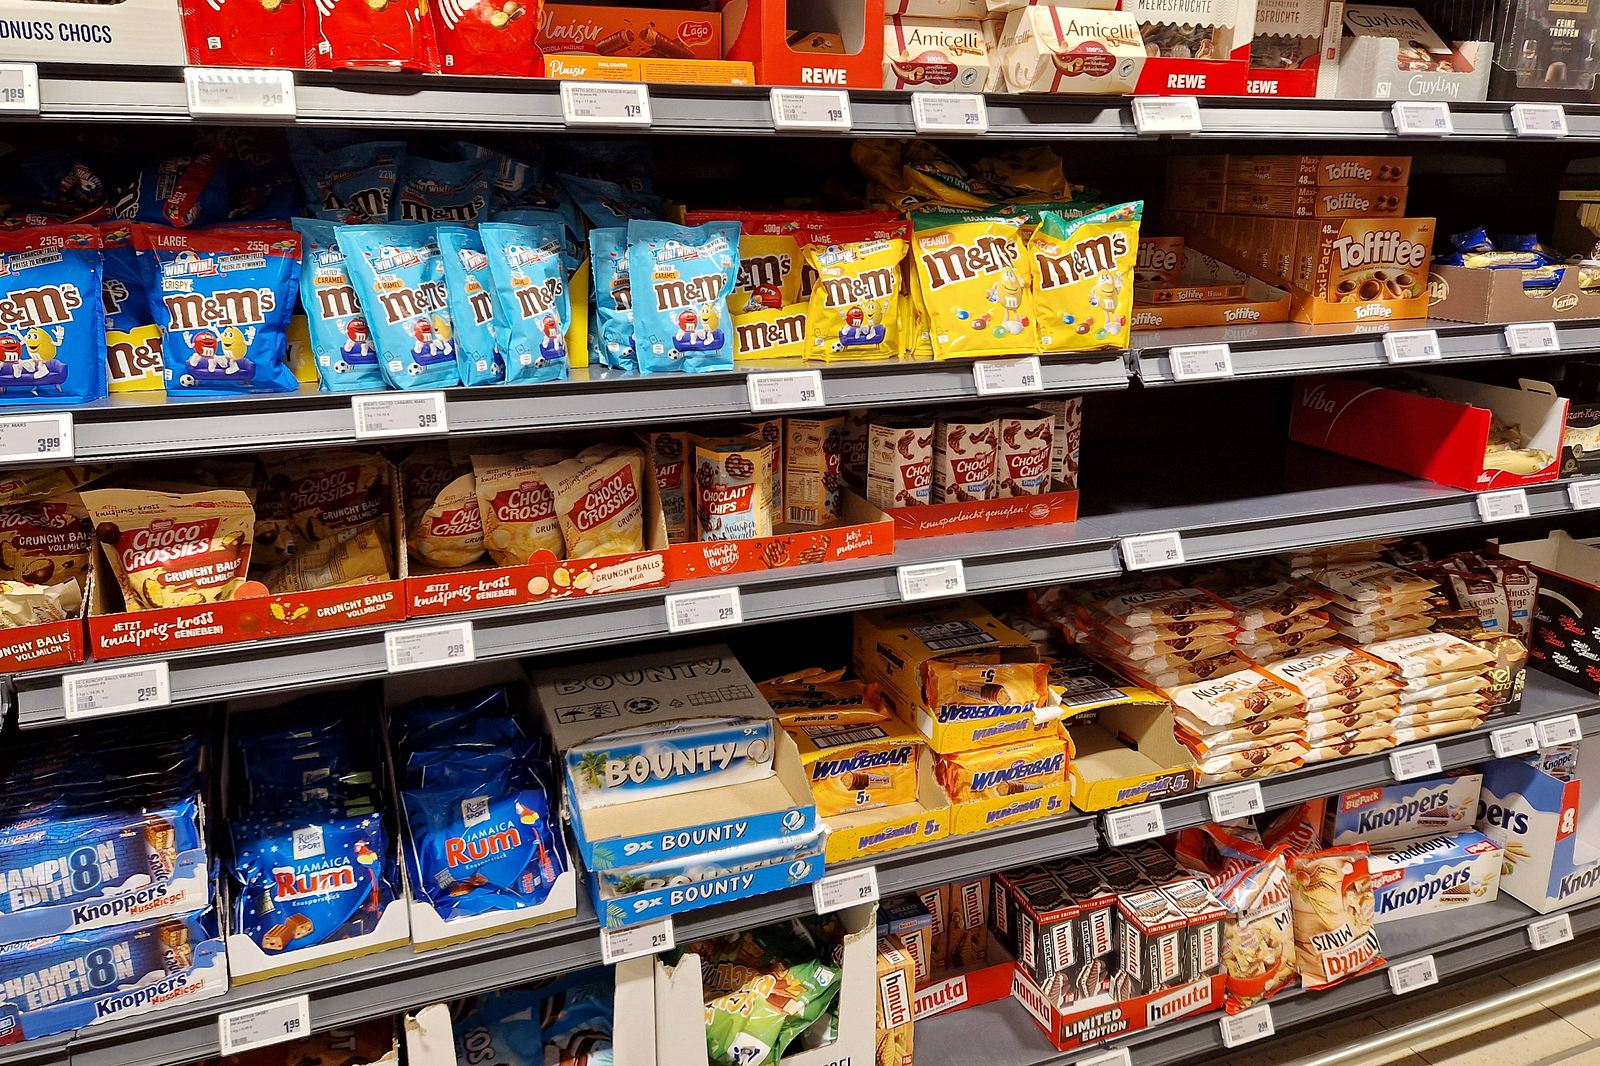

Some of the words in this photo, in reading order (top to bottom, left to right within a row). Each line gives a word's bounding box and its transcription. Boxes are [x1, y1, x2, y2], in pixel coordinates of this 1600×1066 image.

[683, 24, 708, 37] Lago
[1065, 20, 1134, 39] Amicelli
[1549, 28, 1579, 37] TROPFEN
[1556, 19, 1575, 28] FEINE
[59, 24, 112, 44] CHOCS
[908, 29, 978, 48] Amicelli
[550, 59, 587, 77] Plaisir
[802, 67, 847, 84] REWE
[1167, 74, 1207, 89] REWE
[1247, 80, 1278, 94] REWE
[1298, 175, 1308, 184] 48
[1325, 162, 1373, 181] Toffifee
[1296, 207, 1306, 216] 48
[1322, 193, 1370, 211] Toffifee
[764, 224, 781, 234] 300g
[811, 234, 832, 243] LARGE
[874, 231, 890, 240] 300g
[1321, 224, 1332, 234] 48
[40, 236, 64, 247] 255g
[158, 235, 187, 246] LARGE
[247, 240, 269, 254] 255g
[923, 234, 949, 247] PEANUT
[1332, 230, 1426, 270] Toffifee
[165, 263, 188, 276] WIN!
[188, 260, 212, 272] WIN!
[1037, 232, 1127, 289] m&m's
[164, 281, 188, 289] CRISPY
[317, 276, 344, 284] CARAMEL
[655, 272, 677, 280] CARAMEL
[380, 282, 447, 323] m&m's
[1178, 290, 1203, 300] Toffifee
[165, 290, 274, 329] m&m's
[1223, 307, 1260, 322] Toffifee
[1354, 303, 1392, 318] Toffifee
[1302, 384, 1337, 413] Viba
[418, 413, 437, 428] 3.99
[37, 437, 60, 453] 3.99
[957, 451, 994, 473] CHOCLAIT
[1012, 448, 1049, 468] CHOCLAIT
[965, 467, 990, 482] CHIPS
[1019, 464, 1044, 477] CHIPS
[301, 470, 347, 493] CHOCO
[585, 475, 623, 510] CHOCO
[703, 486, 749, 502] CHOCLAIT
[323, 504, 360, 521] CRUNCHY
[577, 483, 636, 530] CROSSIES
[709, 501, 737, 513] CHIPS
[919, 508, 985, 530] Knusperleicht
[985, 503, 1029, 521] genießen!
[19, 533, 66, 547] CRUNCHY
[132, 524, 200, 551] CHOCO
[122, 537, 210, 572] CROSSIES
[703, 543, 738, 559] Knusper
[708, 552, 740, 568] Brezeln
[164, 566, 213, 583] CRUNCHY
[215, 557, 242, 574] BALLS
[196, 572, 236, 587] VOLLMILCH
[596, 568, 634, 584] CRUNCHY
[636, 560, 661, 574] BALLS
[413, 575, 510, 608] knusprig-kross
[424, 582, 450, 593] JETZT
[317, 600, 362, 618] CRUNCHY
[364, 591, 393, 606] BALLS
[346, 603, 386, 619] VOLLMILCH
[100, 611, 214, 648] knusprig-kross
[112, 620, 141, 632] JETZT
[36, 632, 71, 649] BALLS
[15, 645, 63, 663] VOLLMILCH
[553, 657, 723, 696] BOUNTY
[980, 668, 995, 682] 5x
[137, 686, 158, 702] 2.99
[743, 728, 759, 737] 9x
[971, 717, 1029, 742] WUNDERBAR
[604, 742, 737, 789] BOUNTY
[812, 746, 913, 782] WUNDERBAR
[970, 753, 1064, 792] WUNDERBAR
[1173, 775, 1189, 791] 5x
[856, 789, 870, 805] 5x
[1346, 792, 1379, 811] BigPack
[466, 809, 486, 821] SPORT
[986, 798, 1042, 824] WUNDERBAR
[1047, 795, 1062, 811] 5x
[1358, 788, 1449, 835] Knoppers
[1561, 807, 1577, 834] 8x
[467, 820, 515, 843] JAMAICA
[623, 839, 655, 857] 9x
[660, 821, 748, 851] BOUNTY
[858, 822, 918, 851] WUNDERBAR
[924, 819, 940, 836] 5x
[298, 842, 321, 852] SPORT
[445, 828, 522, 868] Rum
[1387, 836, 1455, 865] Knoppers
[296, 856, 350, 875] JAMAICA
[275, 867, 356, 898] Rum
[1172, 884, 1198, 897] hanuta
[1380, 866, 1471, 915] Knoppers
[130, 889, 185, 915] NussRiegel
[633, 896, 663, 914] 9x
[670, 873, 754, 907] BOUNTY
[1131, 892, 1158, 906] hanuta
[73, 882, 168, 925] Knoppers
[966, 884, 982, 929] hanuta
[925, 892, 941, 936] hanuta
[1041, 913, 1060, 922] LIMITED
[1061, 909, 1080, 918] EDITION
[652, 934, 667, 948] 2.19
[1023, 915, 1033, 965] hanuta
[1095, 912, 1108, 954] hanuta
[1312, 923, 1353, 952] MINIS
[1056, 925, 1070, 967] hanuta
[1129, 930, 1138, 973] hanuta
[1203, 927, 1214, 967] hanuta
[905, 936, 922, 980] hanuta
[1163, 937, 1174, 977] hanuta
[96, 973, 187, 1018] Knoppers
[152, 979, 204, 1006] NussRiegel
[886, 974, 905, 1026] hanuta
[1014, 977, 1051, 1023] hanuta
[1150, 986, 1209, 1021] hanuta
[283, 1018, 301, 1035] 1.99
[1065, 1008, 1123, 1038] LIMITED
[1082, 1020, 1127, 1042] EDITION
